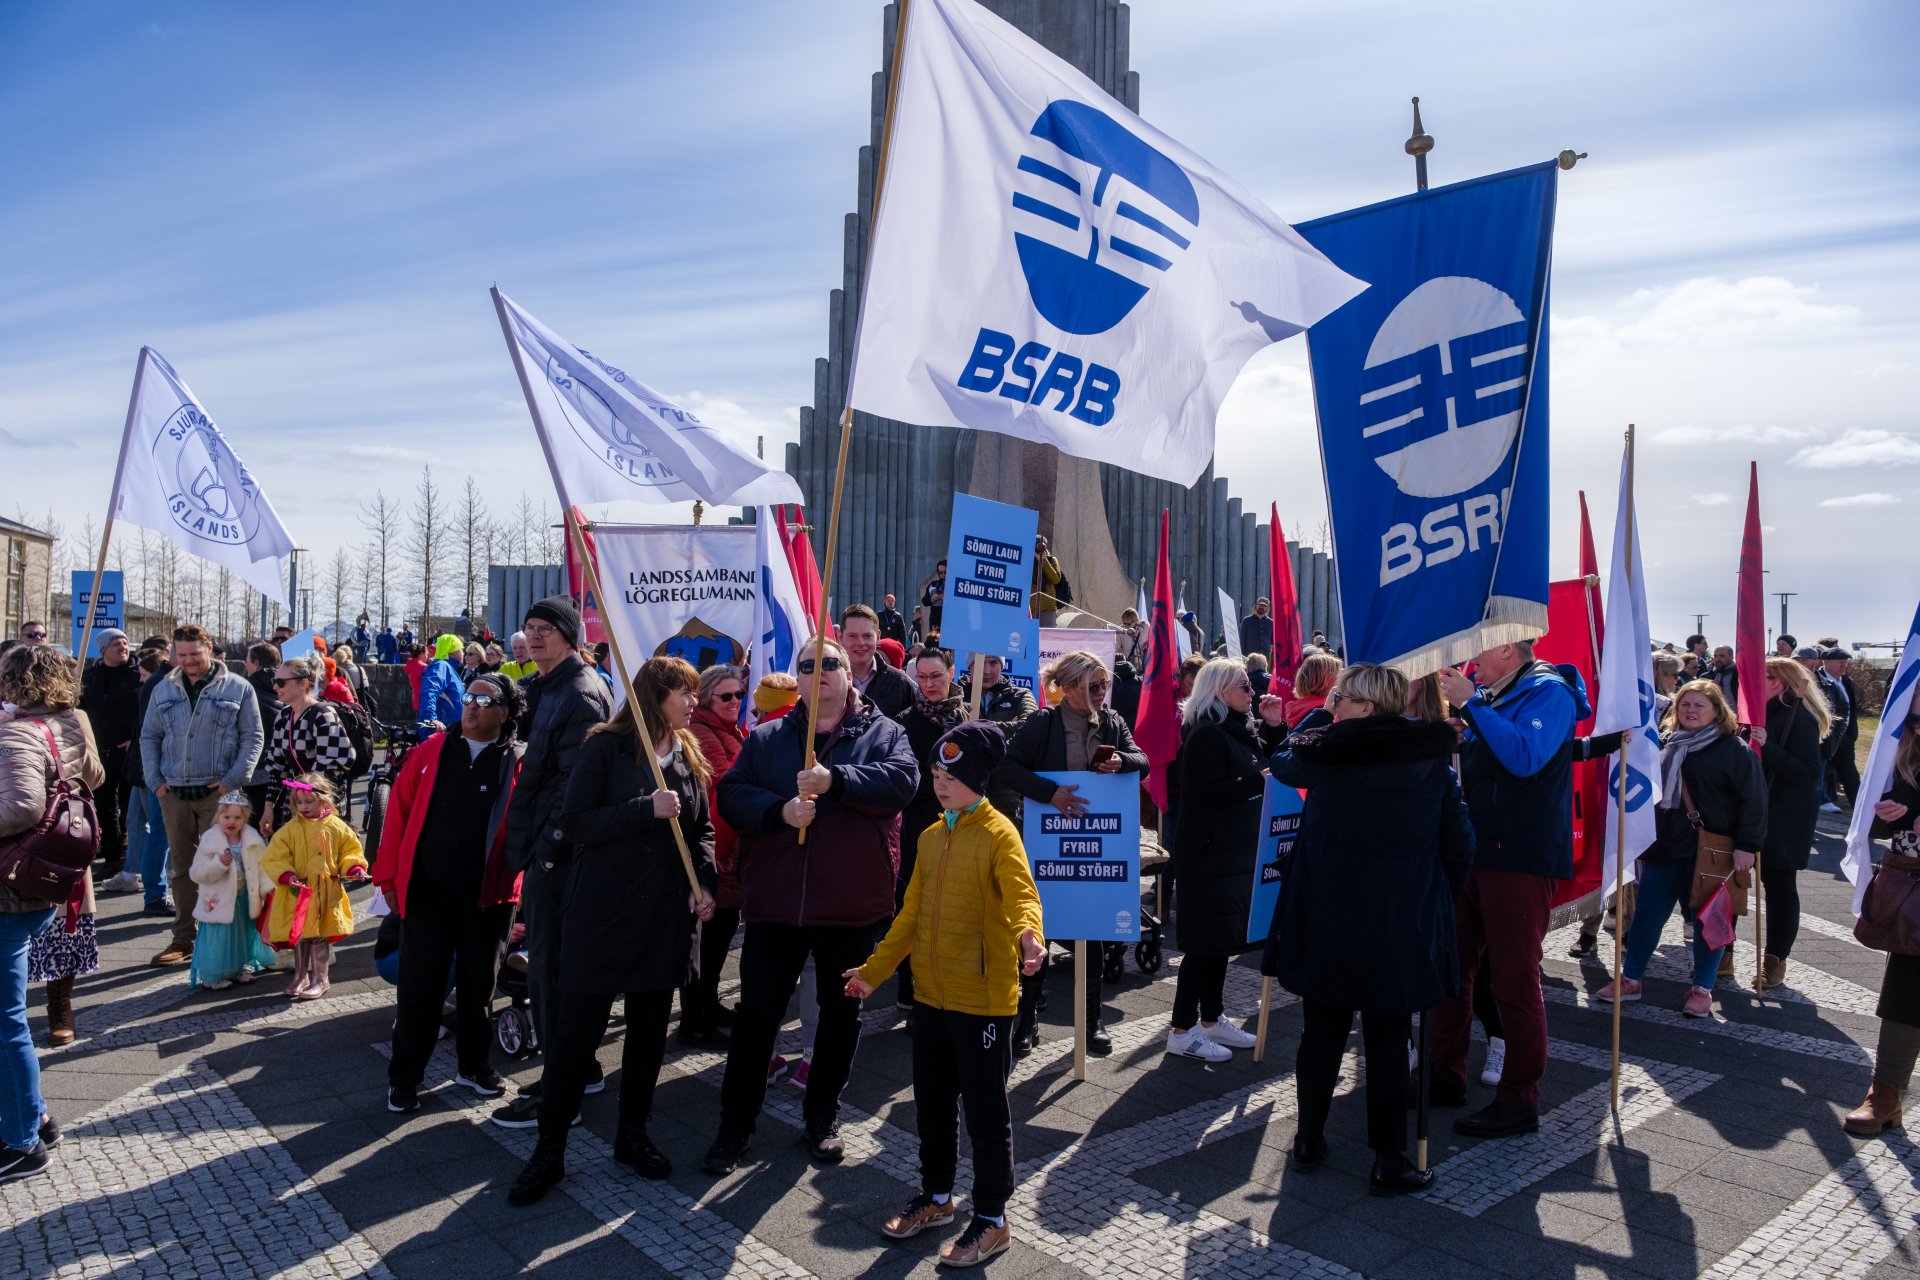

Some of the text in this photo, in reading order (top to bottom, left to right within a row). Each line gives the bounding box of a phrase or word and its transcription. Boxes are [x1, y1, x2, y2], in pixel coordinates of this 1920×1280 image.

[957, 327, 1121, 426] BSRB
[606, 446, 674, 479] ÍSLAN
[168, 493, 239, 539] ÍSLANDS
[966, 539, 1019, 561] SÖMU LAUN
[977, 564, 1005, 579] FYRIR
[625, 586, 755, 605] LÖGREGLUMANN
[957, 580, 1019, 603] SÖMU STÖRF!
[1045, 816, 1118, 830] SÖMU LAUN
[1272, 817, 1301, 833] SÖMU LA
[1063, 841, 1099, 854] FYRIR
[1039, 862, 1124, 877] SÖMU STÖRF!
